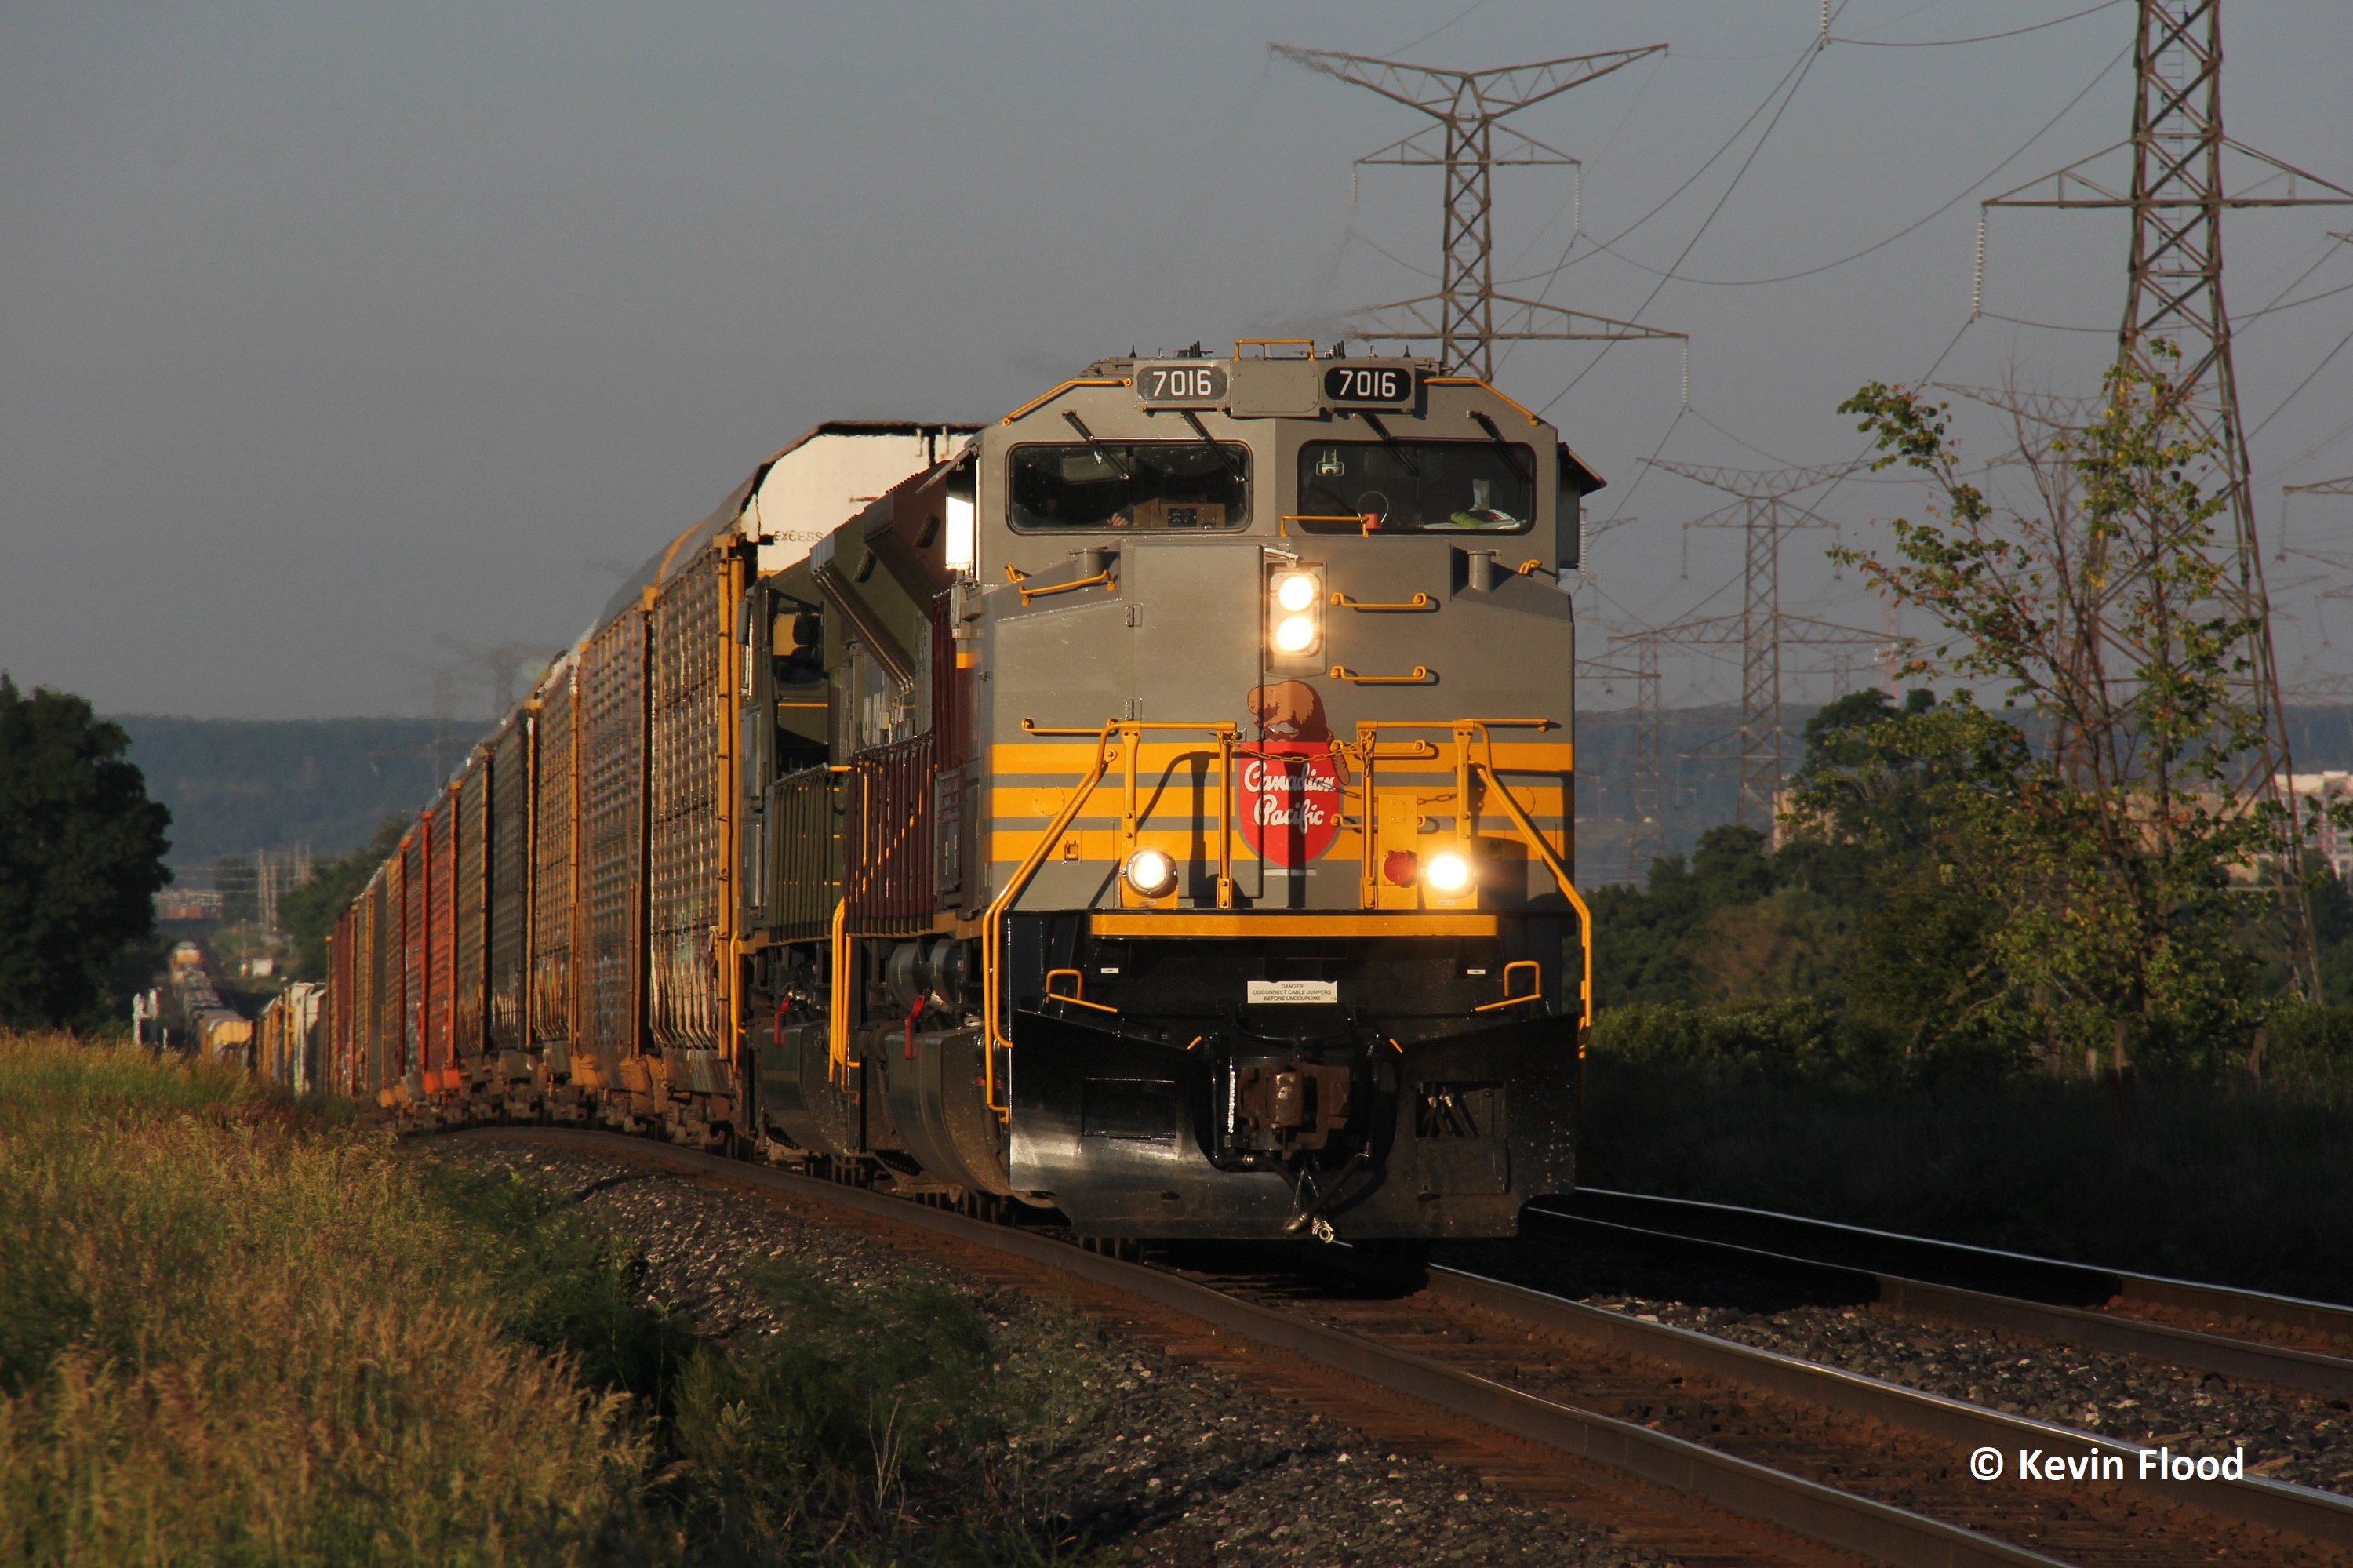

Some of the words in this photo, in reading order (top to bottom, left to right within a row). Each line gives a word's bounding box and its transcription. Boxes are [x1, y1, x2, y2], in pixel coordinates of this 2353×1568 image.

[1152, 369, 1212, 397] 7016
[1339, 369, 1396, 398] 7016
[774, 530, 824, 542] EXCESS
[1244, 760, 1336, 793] Canadian
[1253, 794, 1326, 835] Pacific
